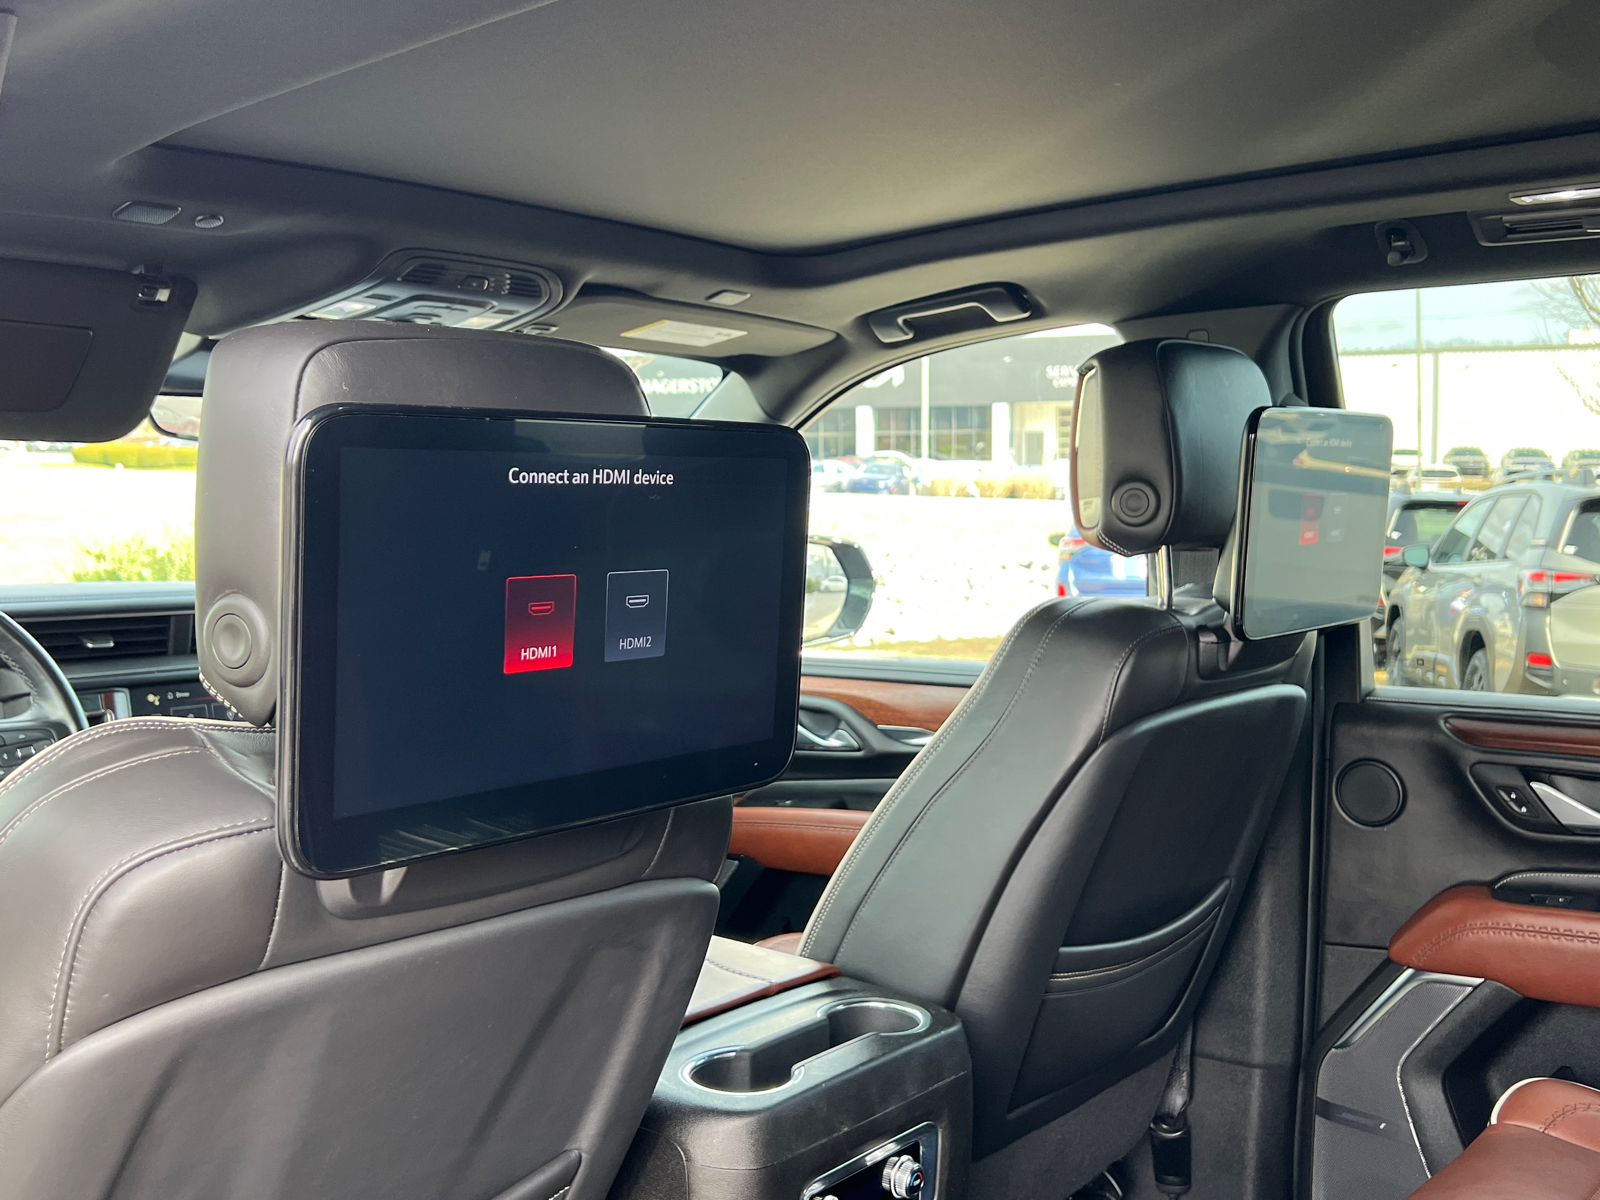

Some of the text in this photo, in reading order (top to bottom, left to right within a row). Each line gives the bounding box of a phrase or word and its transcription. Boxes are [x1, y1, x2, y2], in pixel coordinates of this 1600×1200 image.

[508, 467, 674, 485] Connect an HDMI device
[619, 636, 652, 650] HDMI2
[520, 645, 557, 661] HDMI1
